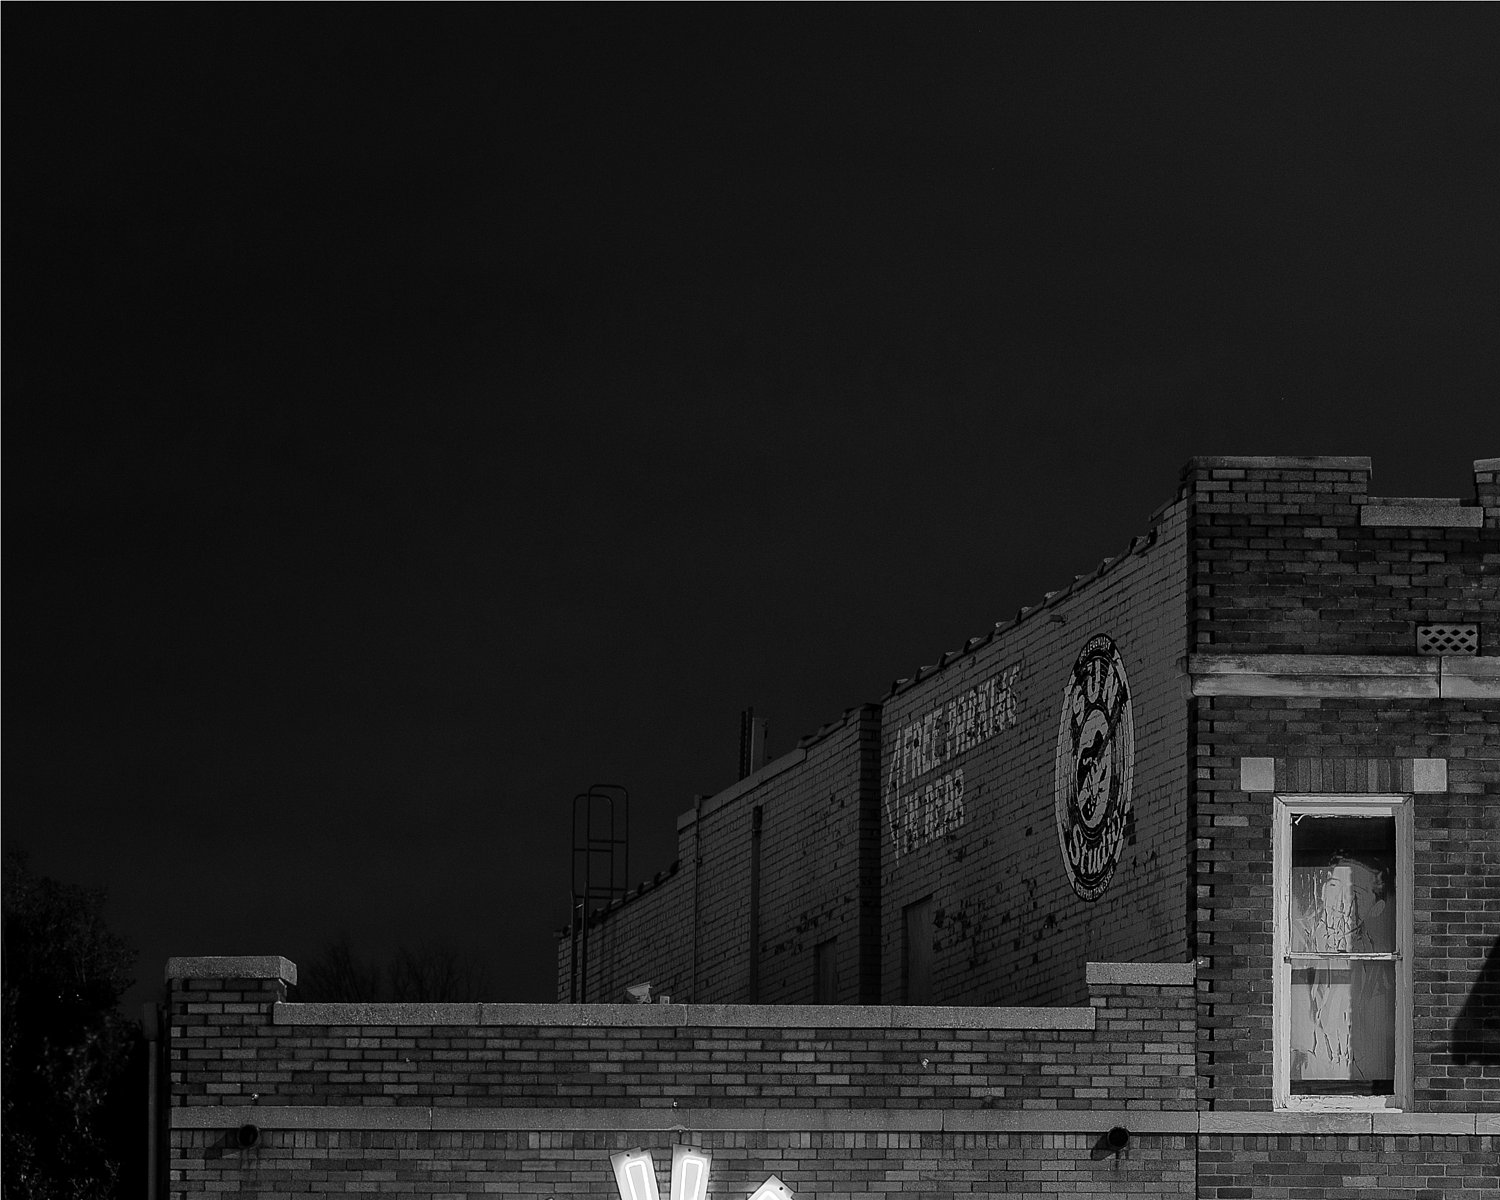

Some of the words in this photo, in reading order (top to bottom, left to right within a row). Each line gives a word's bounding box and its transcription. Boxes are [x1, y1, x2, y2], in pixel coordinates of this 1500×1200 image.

[1071, 658, 1120, 727] SUN
[902, 707, 943, 785] FREE
[924, 768, 966, 846] REAR
[1068, 810, 1121, 875] Studio
